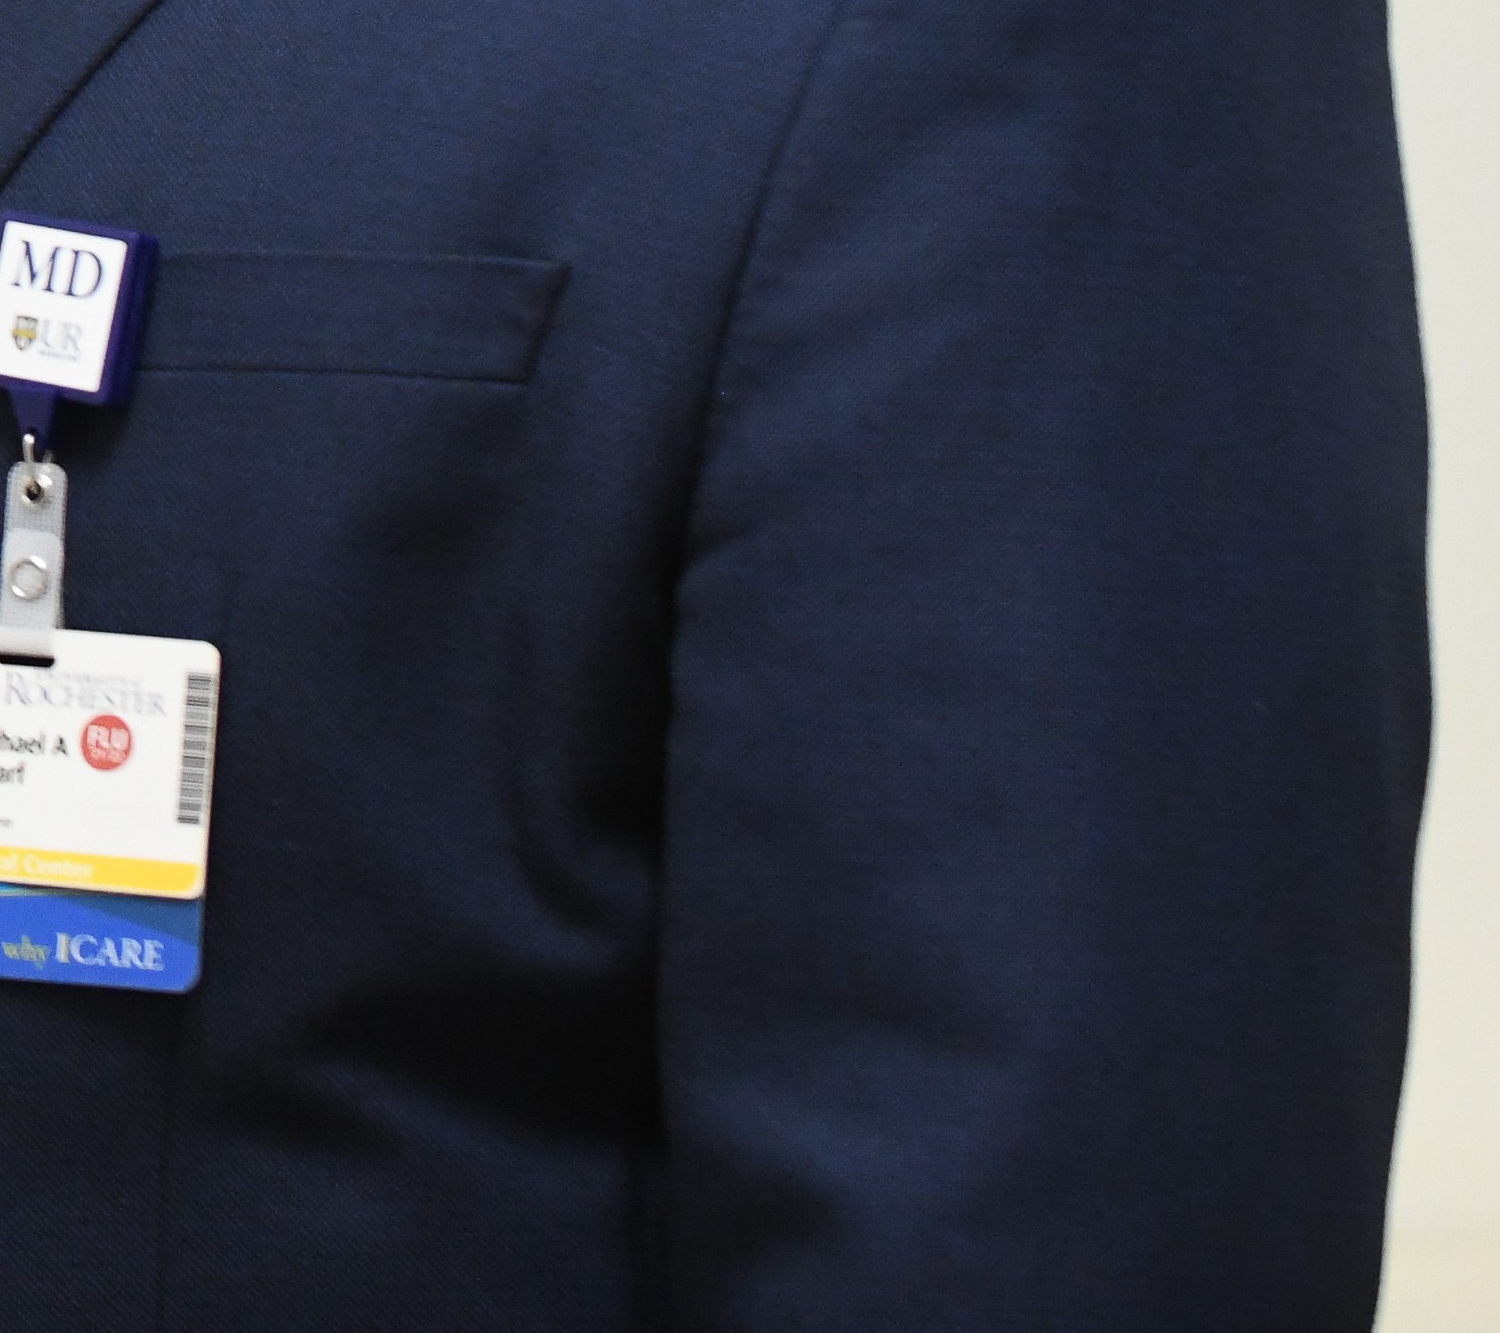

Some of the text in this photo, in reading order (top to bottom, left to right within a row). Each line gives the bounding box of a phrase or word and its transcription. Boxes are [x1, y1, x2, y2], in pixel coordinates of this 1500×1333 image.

[11, 238, 103, 299] MD
[52, 735, 69, 757] A
[2, 934, 50, 970] why
